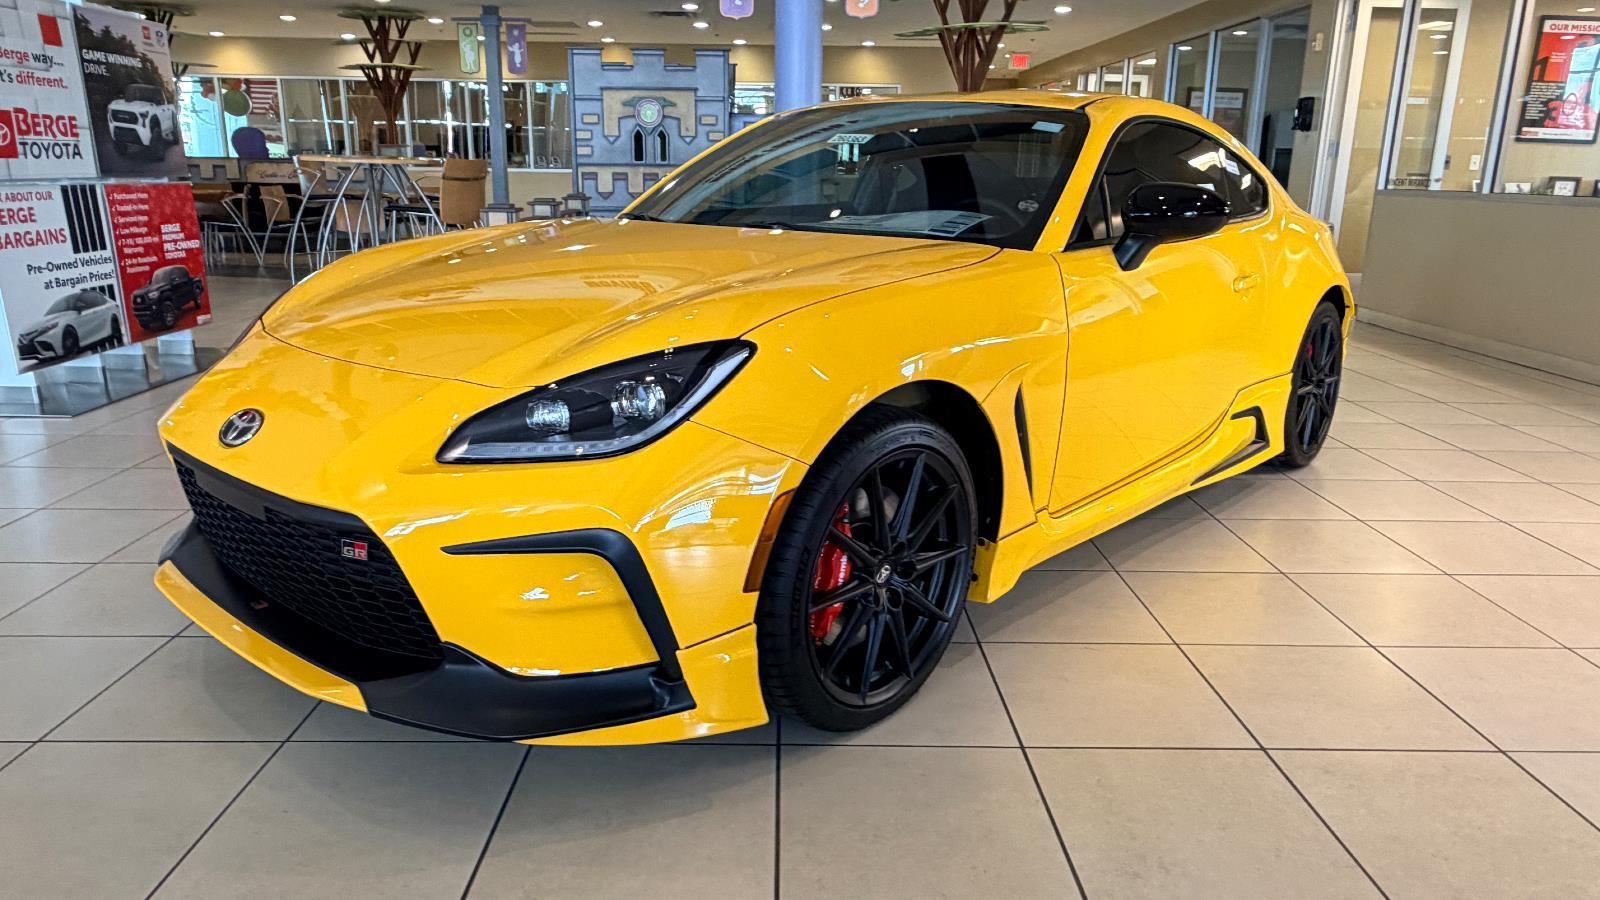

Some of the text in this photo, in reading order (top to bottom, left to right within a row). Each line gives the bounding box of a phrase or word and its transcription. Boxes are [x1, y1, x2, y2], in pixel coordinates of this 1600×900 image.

[1550, 23, 1570, 31] OUR
[31, 52, 64, 68] way...
[82, 48, 107, 63] GAME
[15, 70, 69, 89] different.
[12, 107, 81, 139] BERGE
[19, 141, 84, 160] TOYOTA
[5, 191, 34, 203] ABOUT
[35, 190, 54, 201] OUR
[26, 254, 113, 276] Pre-Owned Vehicles
[43, 268, 115, 290] at Bargain Prices!
[342, 546, 368, 560] GR
